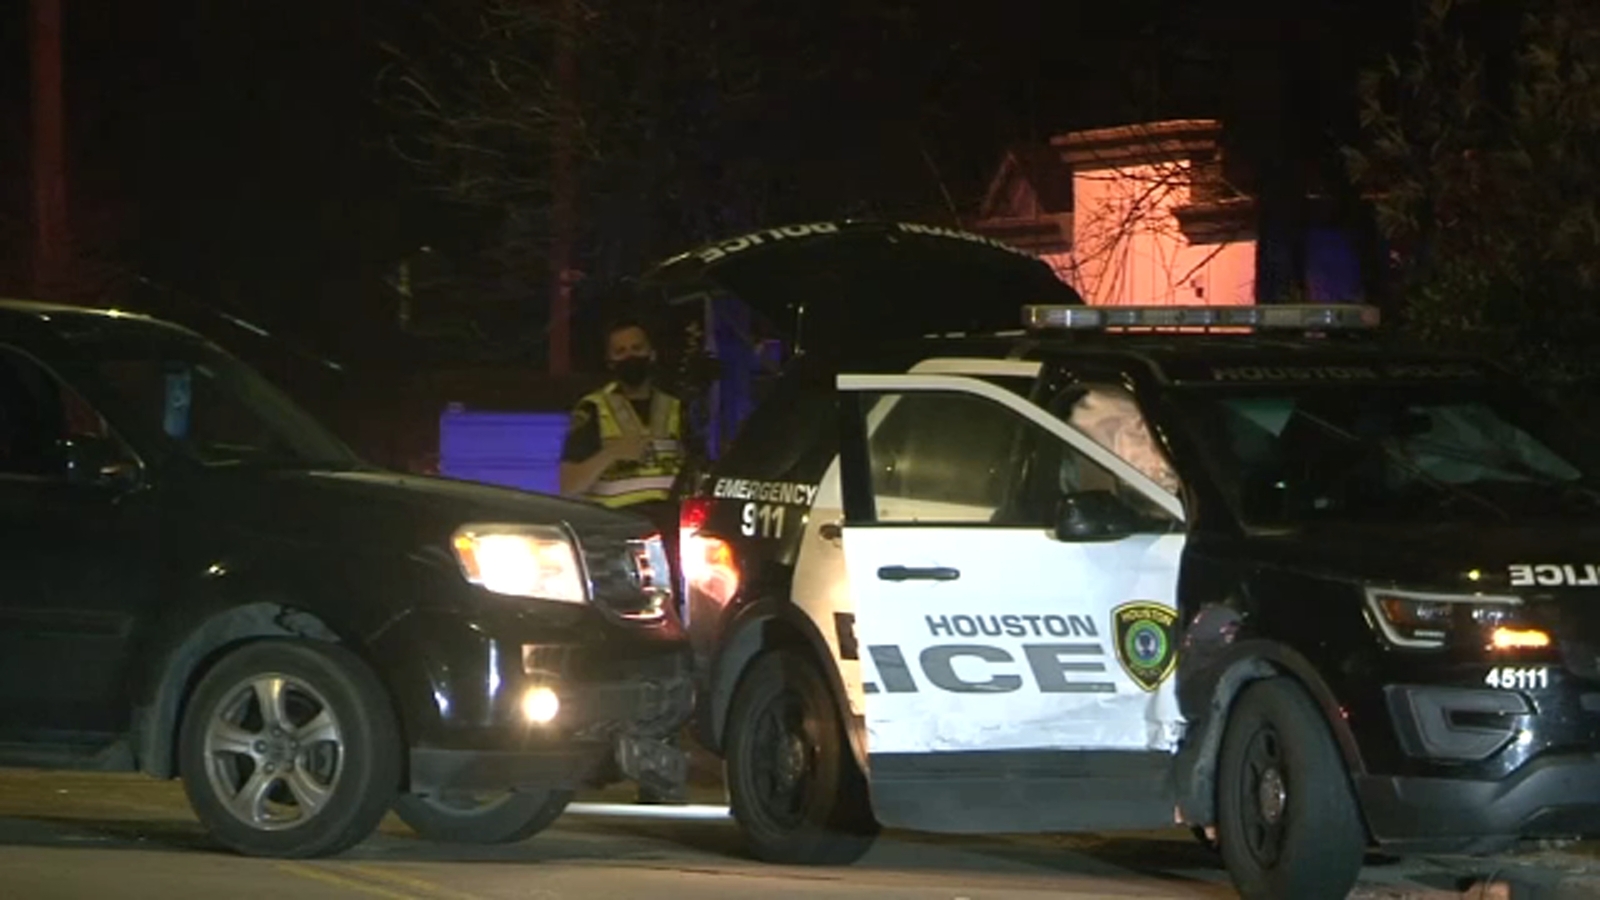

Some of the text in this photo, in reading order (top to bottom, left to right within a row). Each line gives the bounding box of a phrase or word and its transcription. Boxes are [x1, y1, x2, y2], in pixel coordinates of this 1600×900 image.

[698, 222, 839, 263] POLICE
[713, 478, 819, 506] EMERGENCY
[741, 501, 786, 539] 911
[925, 614, 1099, 637] HOUSTON
[1484, 666, 1549, 690] 45111
